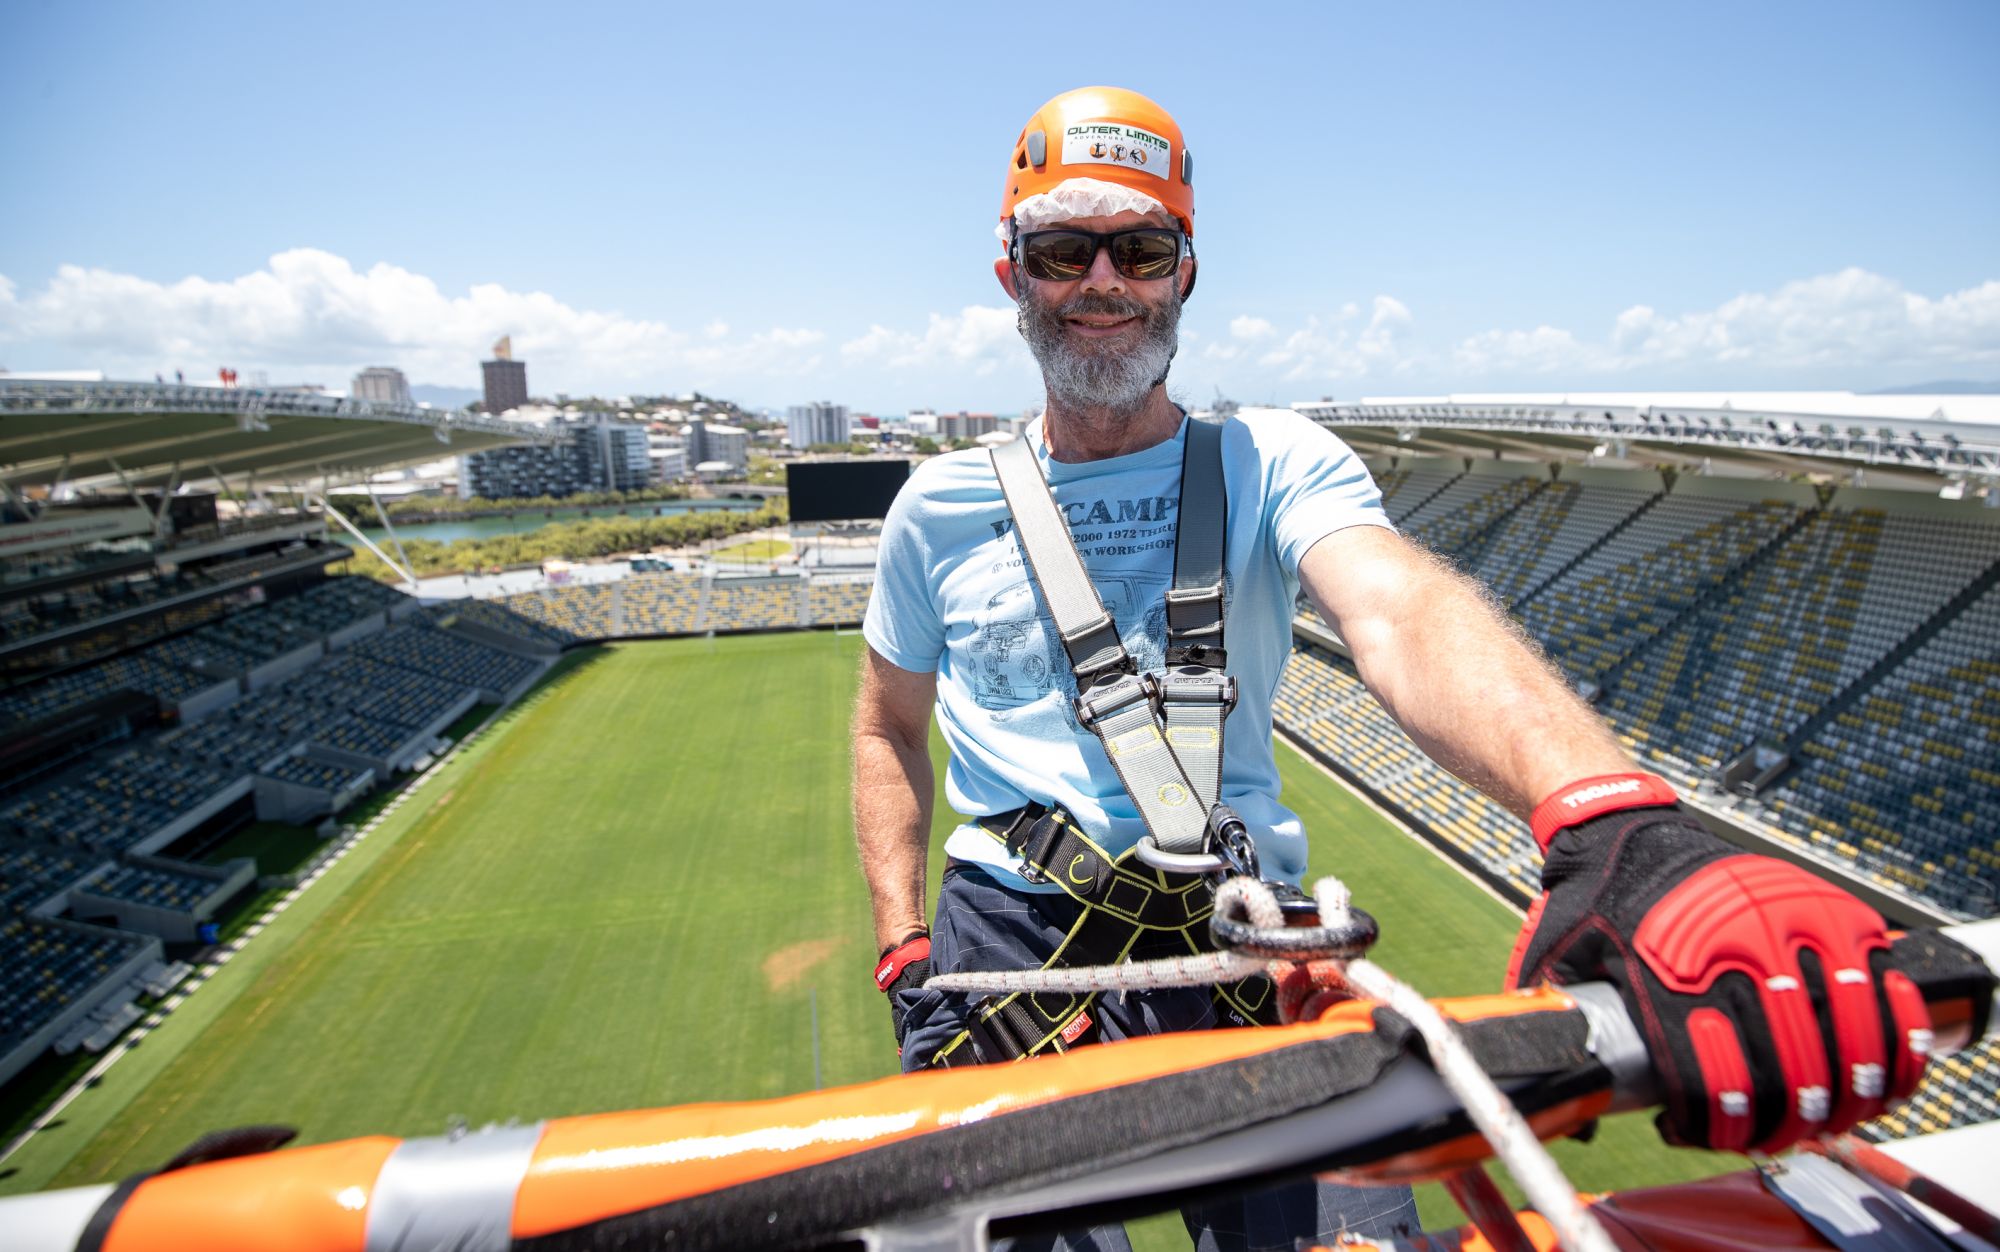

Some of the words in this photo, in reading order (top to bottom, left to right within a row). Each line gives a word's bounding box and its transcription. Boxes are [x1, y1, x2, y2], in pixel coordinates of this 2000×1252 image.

[1067, 126, 1120, 136] OUTER
[1062, 496, 1178, 527] CAMP
[1107, 529, 1136, 539] 1972
[1139, 523, 1176, 538] THRU
[1063, 1013, 1087, 1037] Right
[1229, 1010, 1245, 1026] Left
